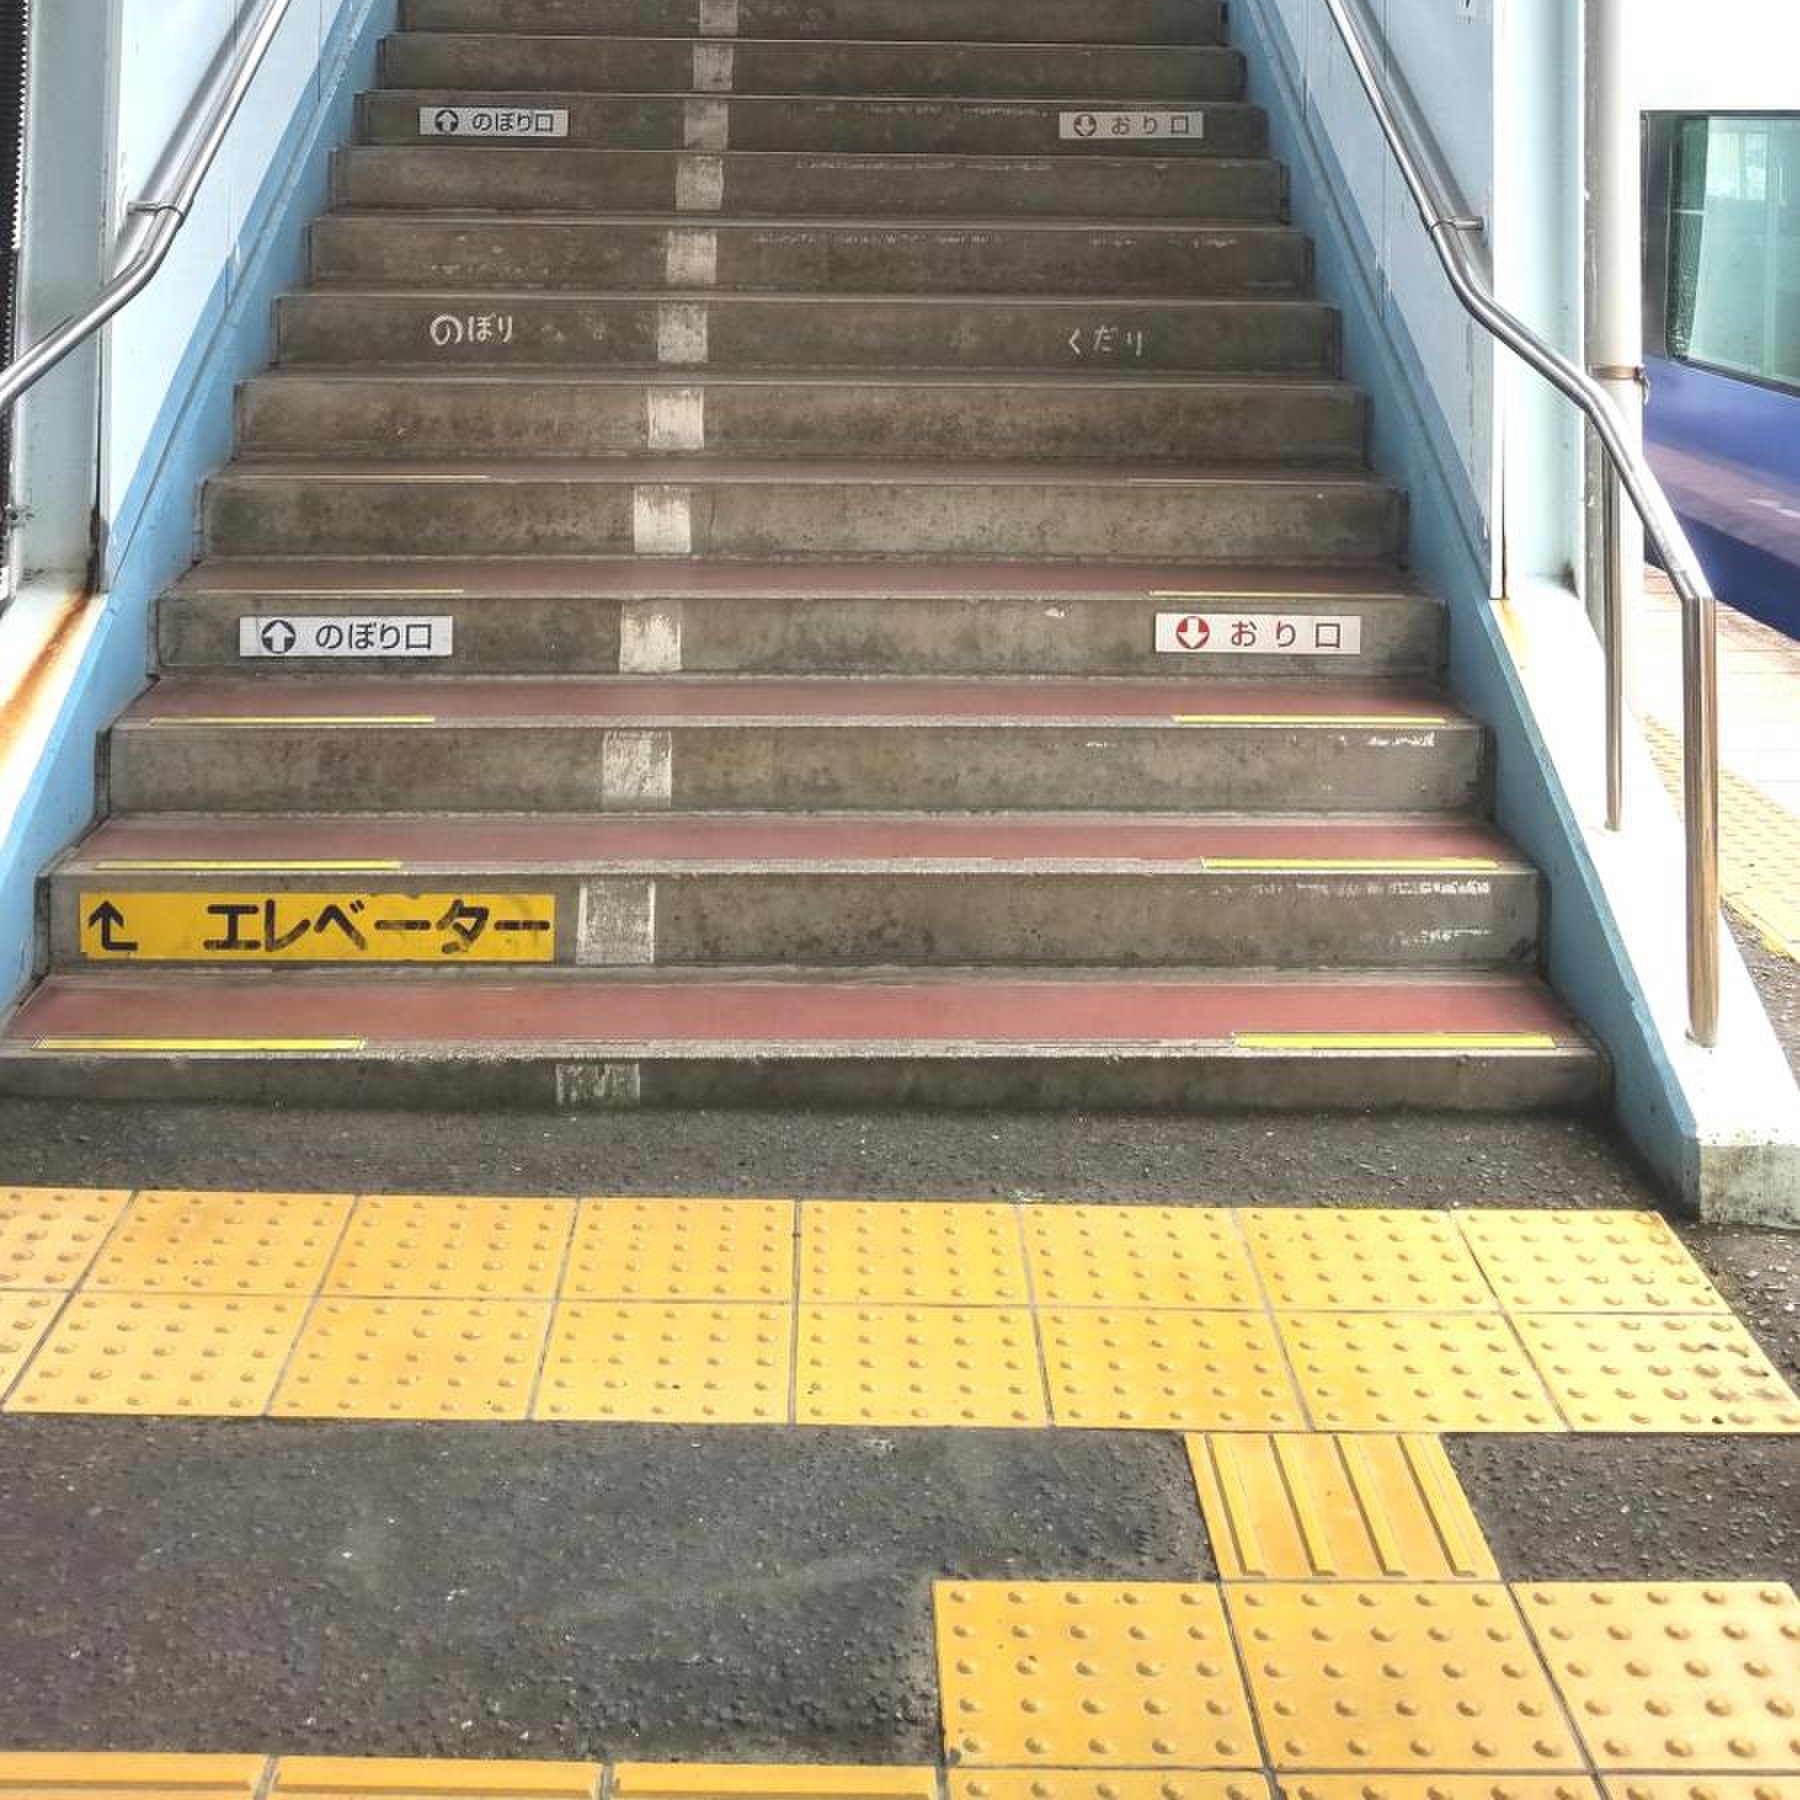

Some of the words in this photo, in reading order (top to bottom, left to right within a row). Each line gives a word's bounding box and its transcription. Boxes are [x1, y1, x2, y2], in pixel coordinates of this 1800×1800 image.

[472, 110, 554, 132] のぼり口
[1111, 116, 1190, 135] おり口
[429, 312, 514, 346] のぼり
[1068, 325, 1143, 357] くだり
[315, 621, 433, 651] のぼり口
[1230, 620, 1342, 649] おり口
[203, 898, 551, 954] エレベーター
